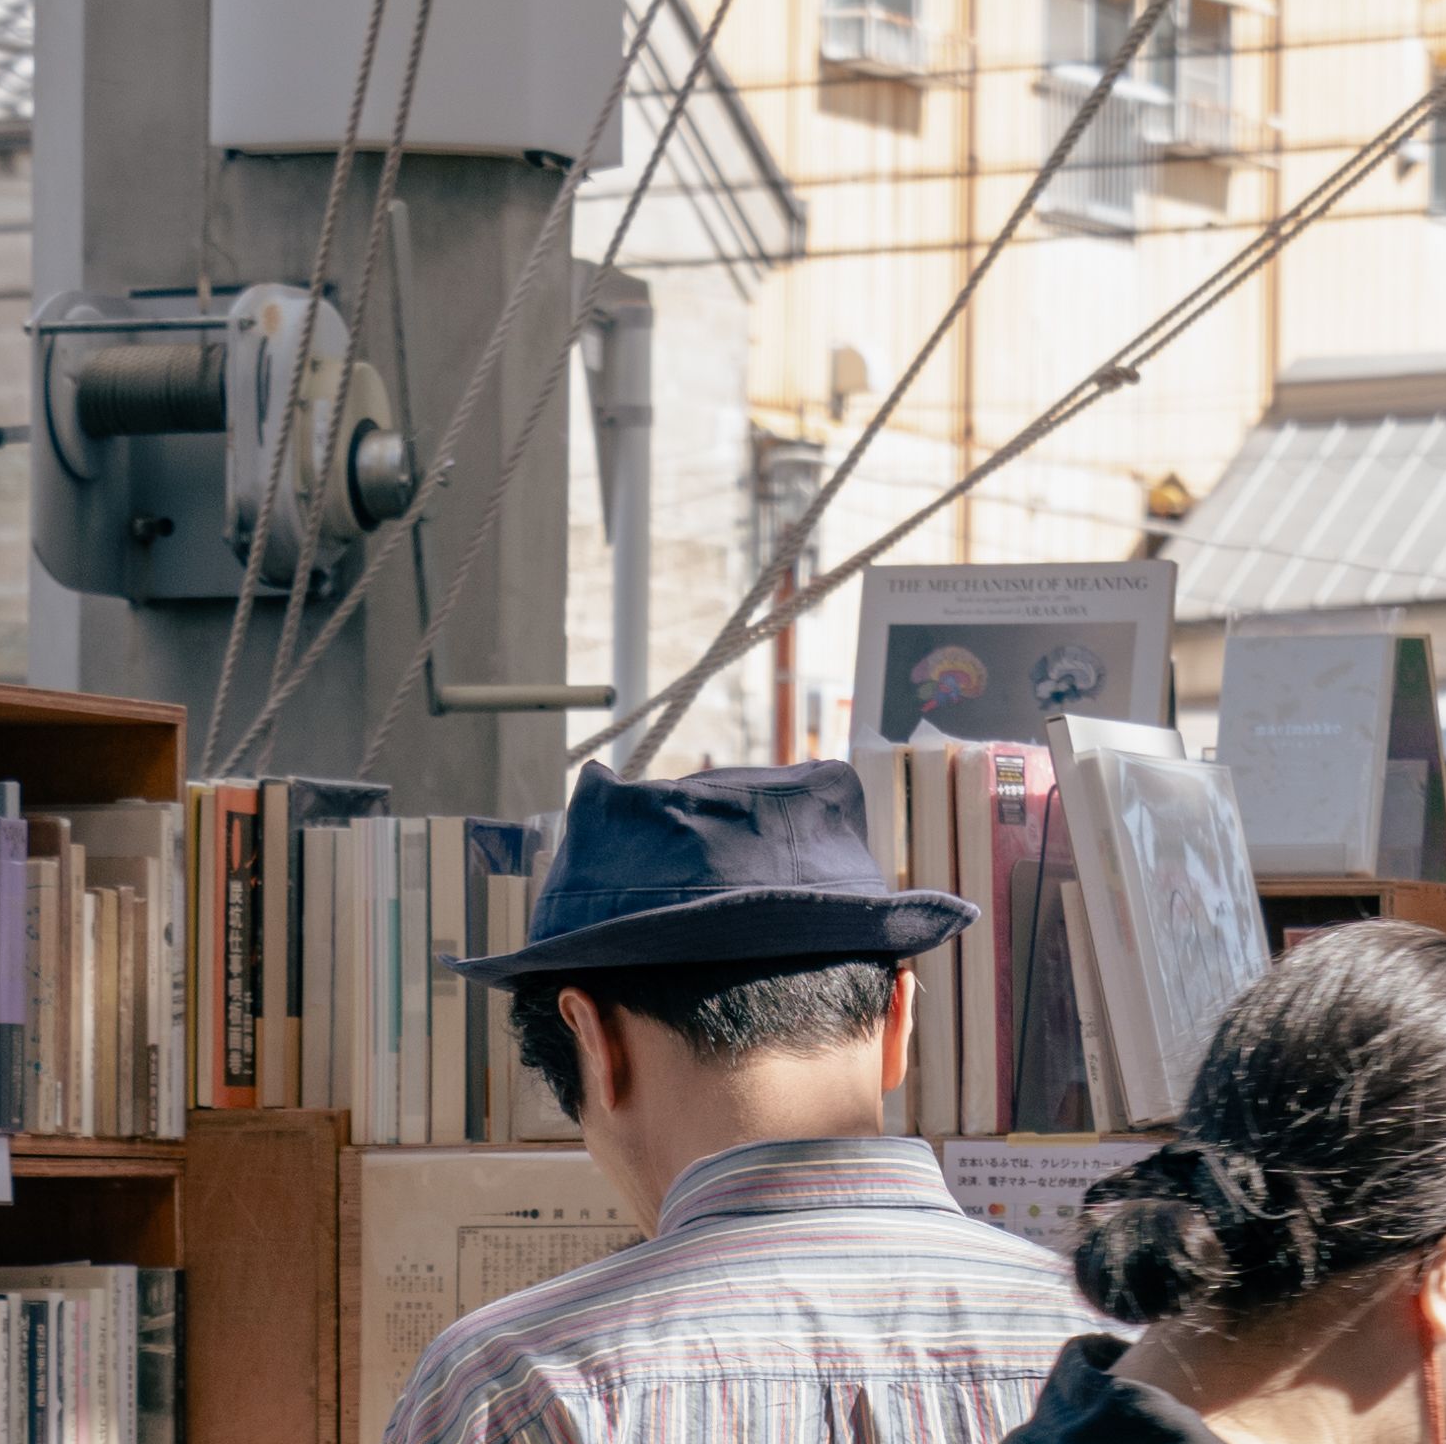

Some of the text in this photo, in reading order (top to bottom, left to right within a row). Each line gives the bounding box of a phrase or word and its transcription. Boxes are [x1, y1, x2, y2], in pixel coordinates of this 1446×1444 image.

[887, 576, 1148, 593] THE MECHANISM OF MEANING
